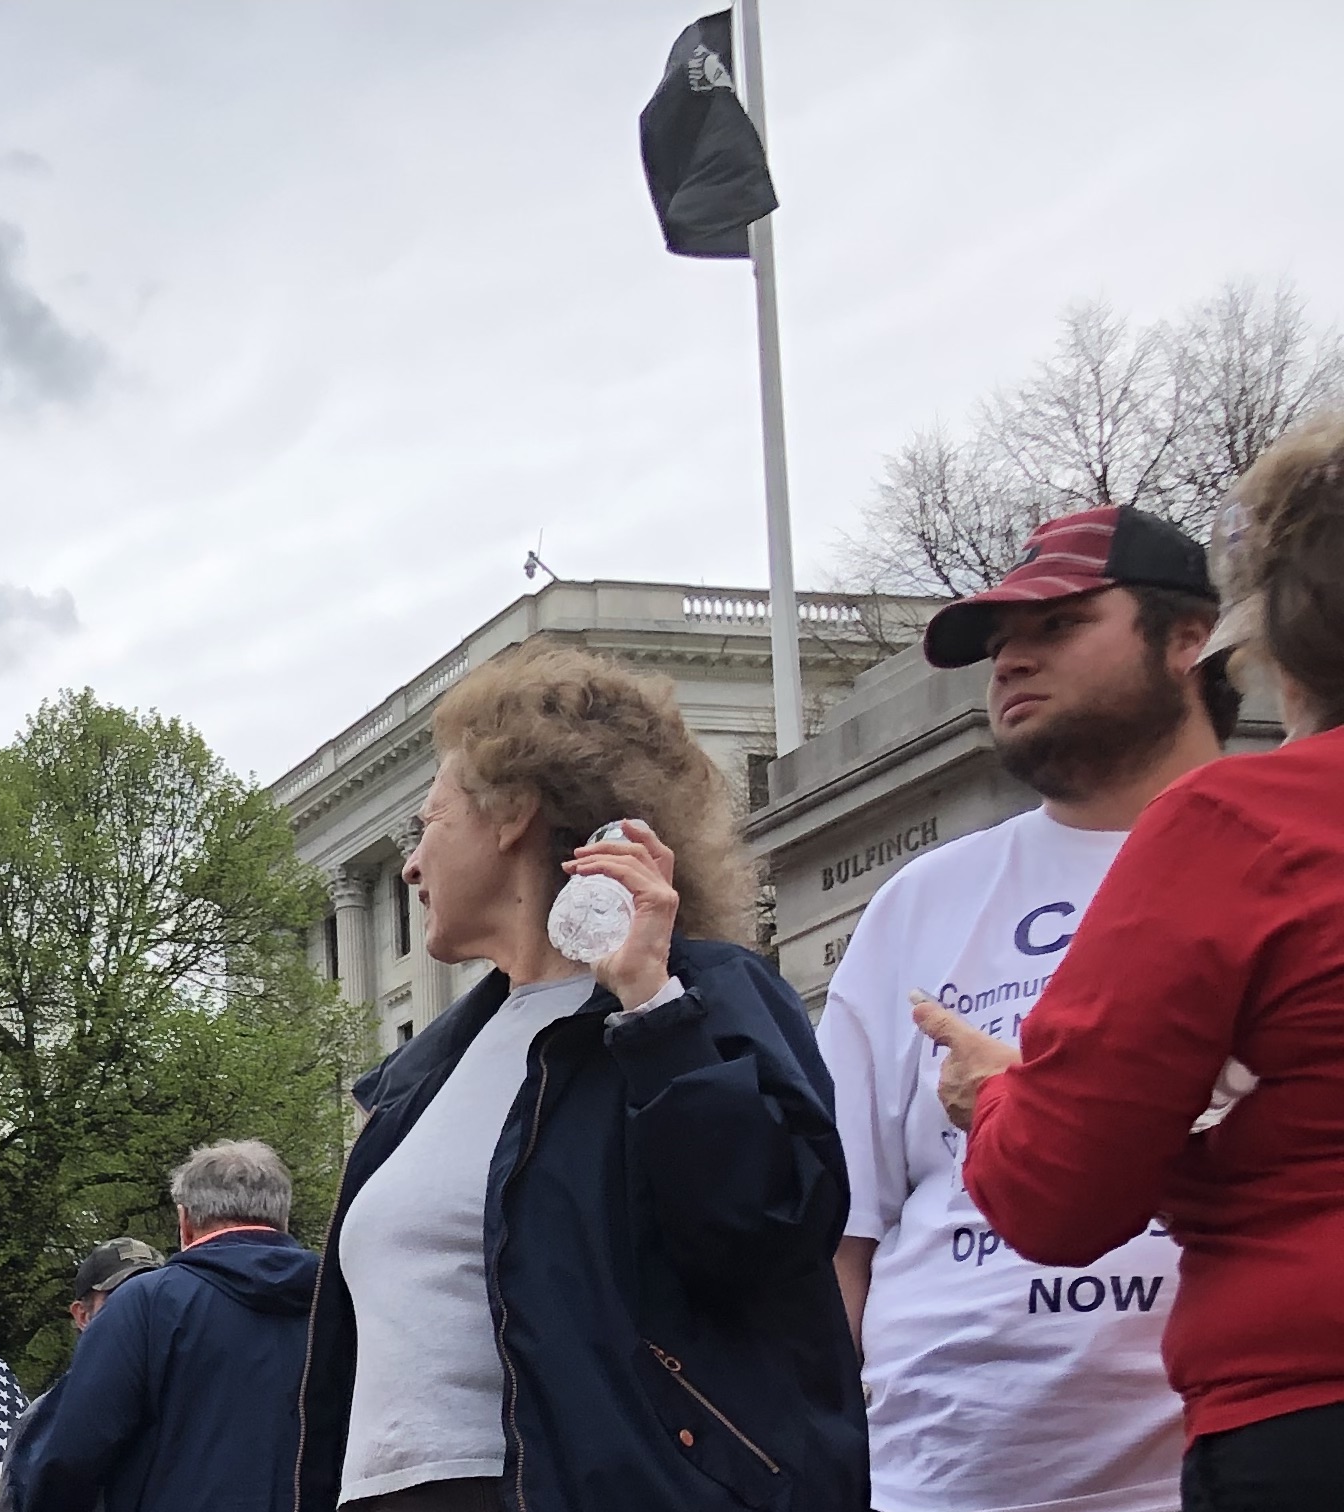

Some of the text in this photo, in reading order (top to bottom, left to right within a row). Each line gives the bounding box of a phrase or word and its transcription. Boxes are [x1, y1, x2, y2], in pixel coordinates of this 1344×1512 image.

[821, 816, 939, 892] BULFINCH
[952, 1227, 1014, 1267] Op
[1028, 1275, 1164, 1314] NOW
